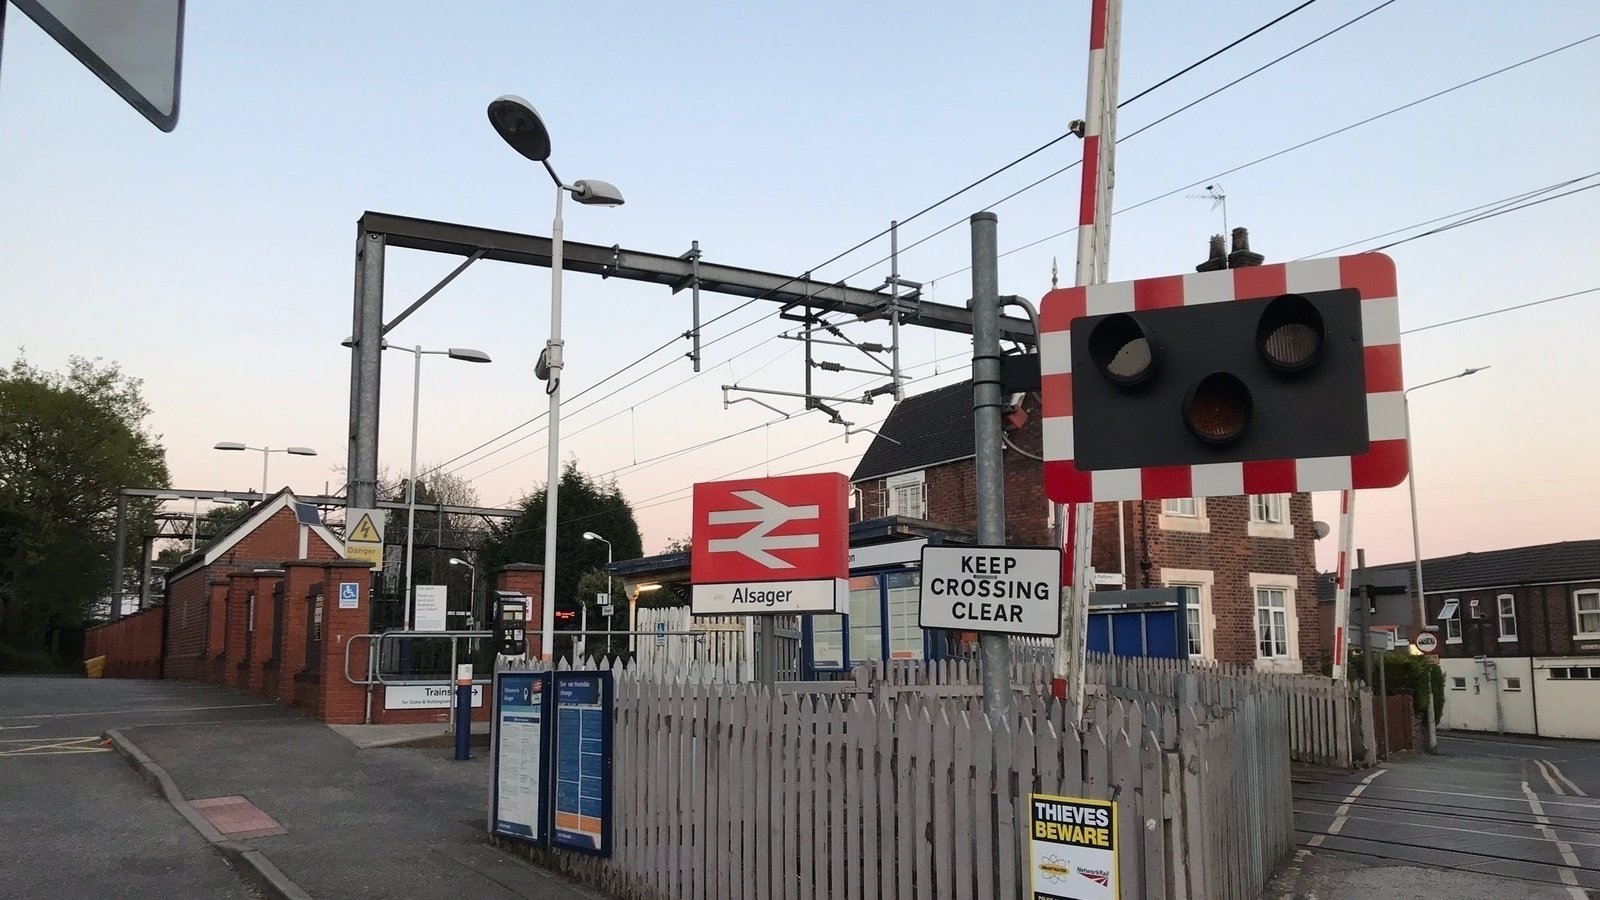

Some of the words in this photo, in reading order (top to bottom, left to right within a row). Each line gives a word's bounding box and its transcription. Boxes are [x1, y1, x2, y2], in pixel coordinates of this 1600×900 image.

[347, 546, 376, 556] Danger
[961, 555, 1017, 575] KEEP
[732, 587, 793, 607] Alsager
[930, 577, 1049, 600] CROSSING
[601, 595, 604, 604] 1
[951, 601, 1024, 623] CLEAR
[425, 687, 452, 697] Trains
[1035, 802, 1109, 827] THIEVES
[1035, 820, 1109, 847] BEWARE
